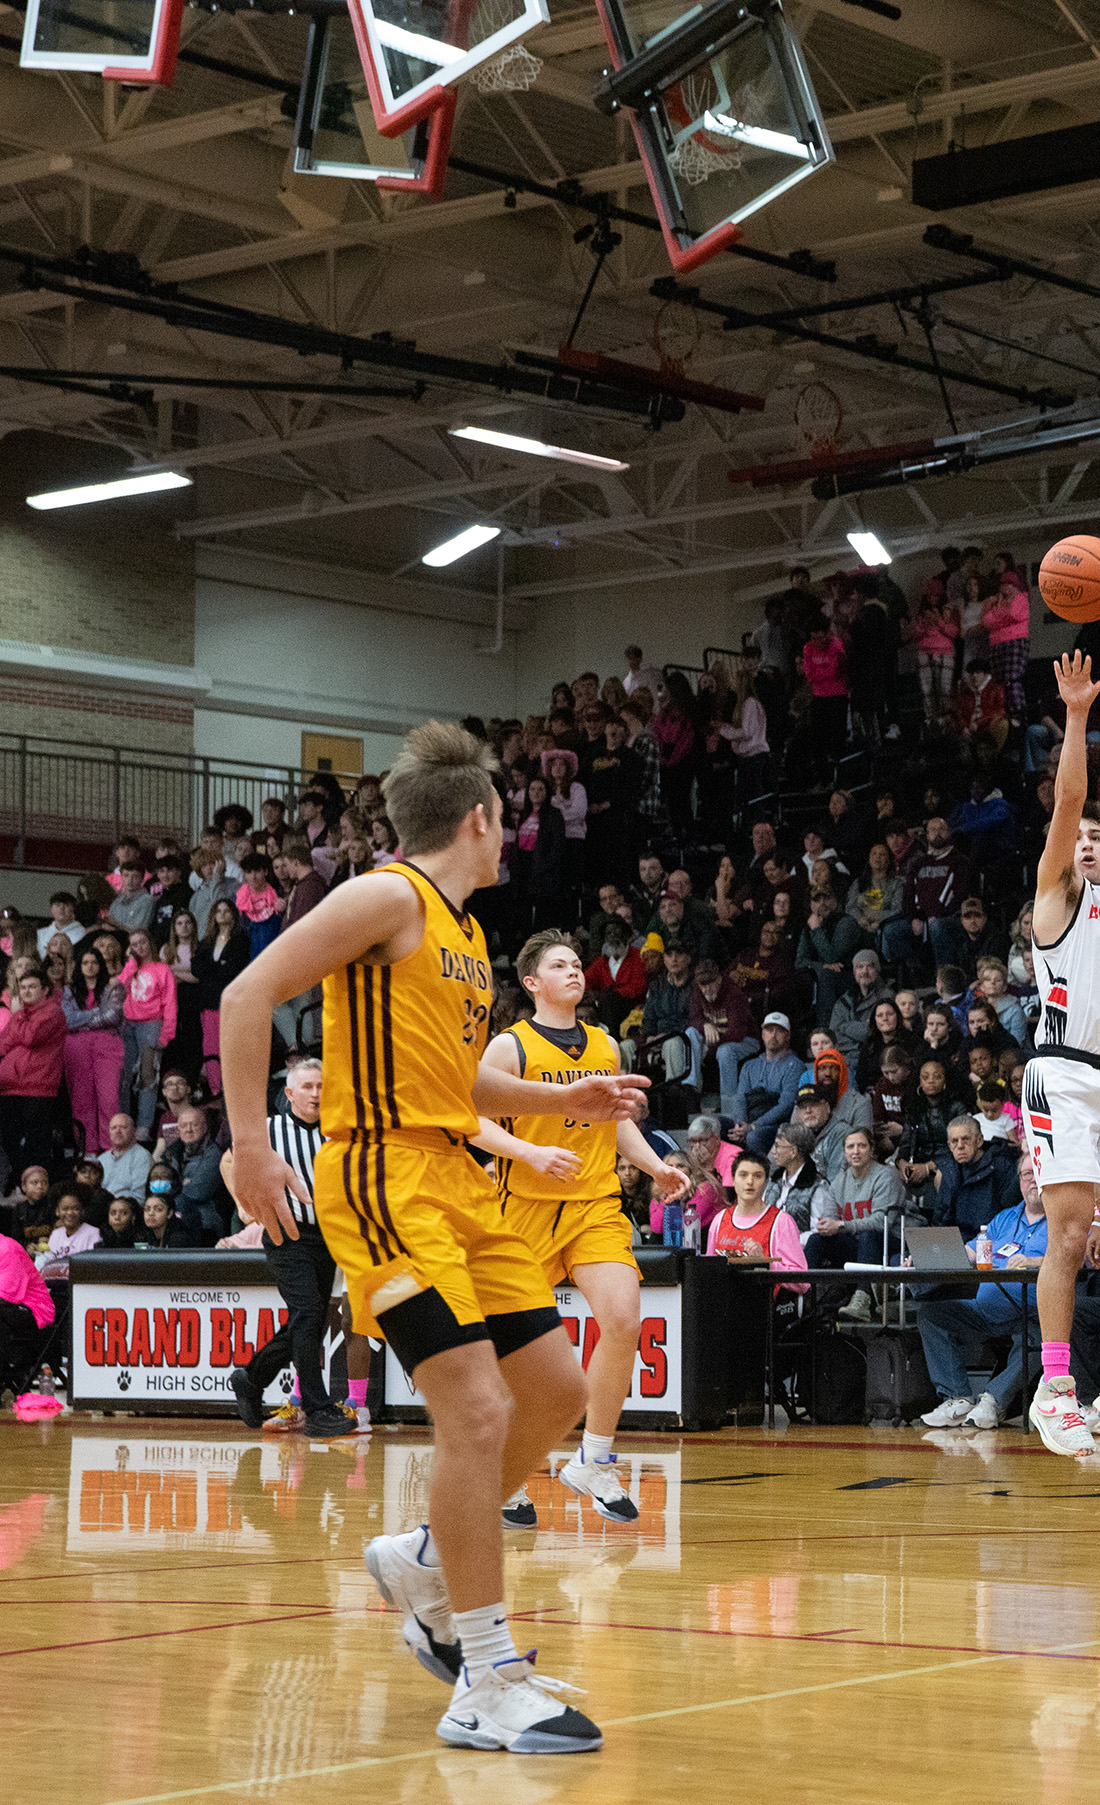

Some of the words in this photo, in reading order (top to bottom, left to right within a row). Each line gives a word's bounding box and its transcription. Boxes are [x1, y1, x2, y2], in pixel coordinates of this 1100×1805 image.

[1041, 580, 1084, 601] Rawling
[440, 946, 492, 990] DAVIS
[169, 1291, 223, 1303] WELCOME
[226, 1292, 241, 1303] TO
[85, 1308, 201, 1367] GRAND
[146, 1375, 186, 1390] HIGH
